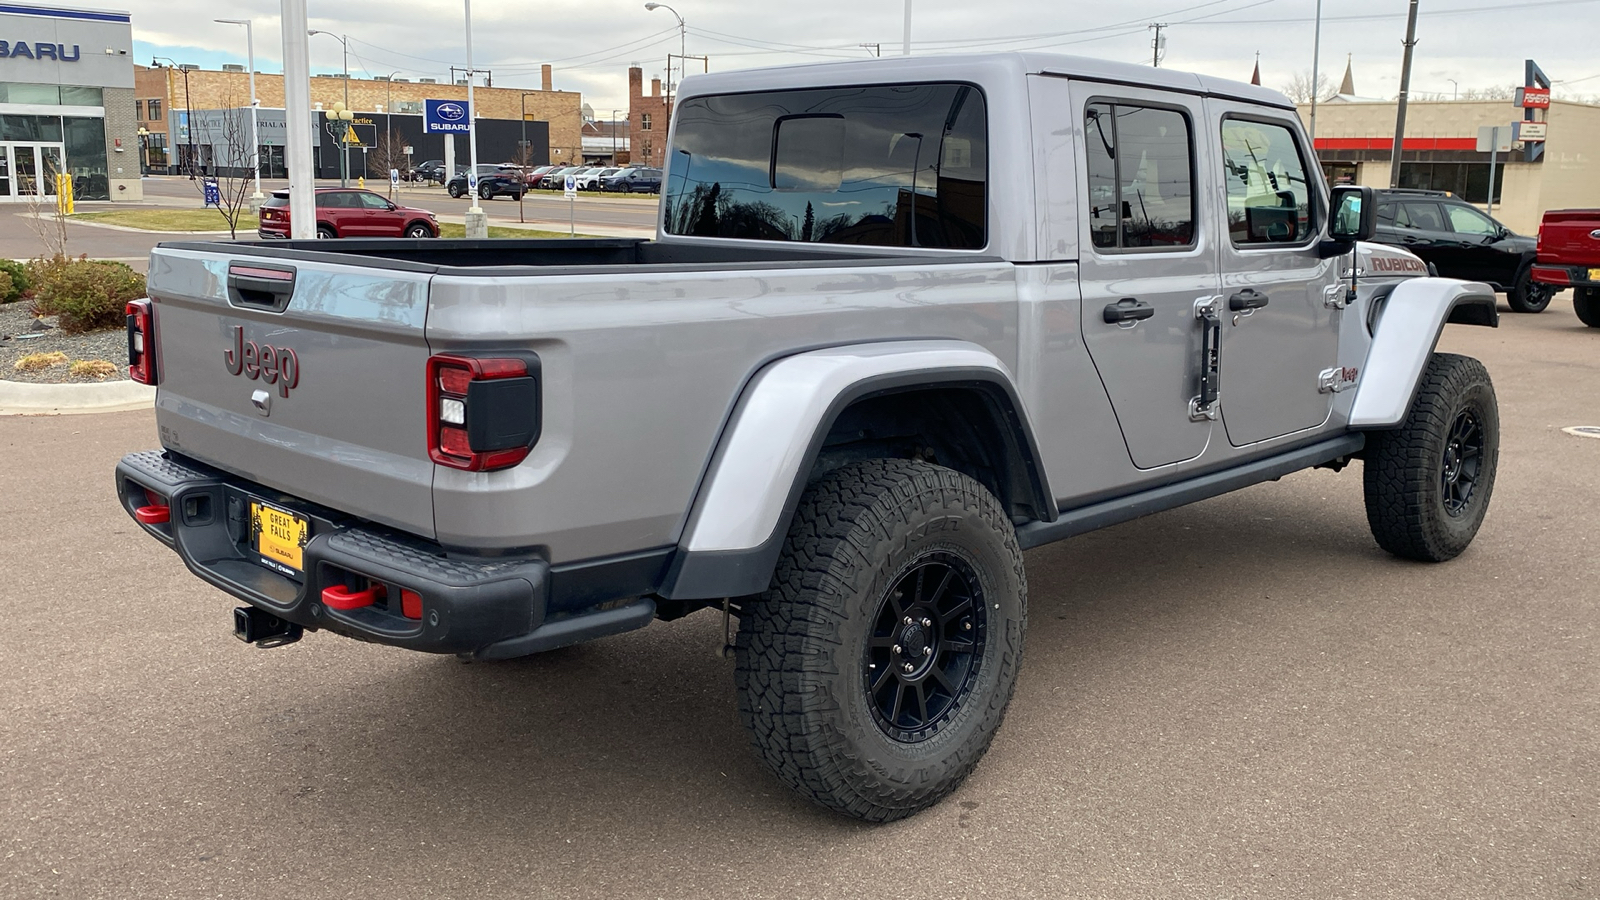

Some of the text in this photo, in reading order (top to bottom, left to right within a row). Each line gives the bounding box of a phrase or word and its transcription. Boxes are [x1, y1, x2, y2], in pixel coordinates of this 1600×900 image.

[430, 122, 470, 131] SUBARU
[1370, 257, 1427, 273] RUBICON
[224, 325, 299, 398] Jeep
[269, 513, 290, 529] GREAT
[270, 524, 291, 541] FALLS
